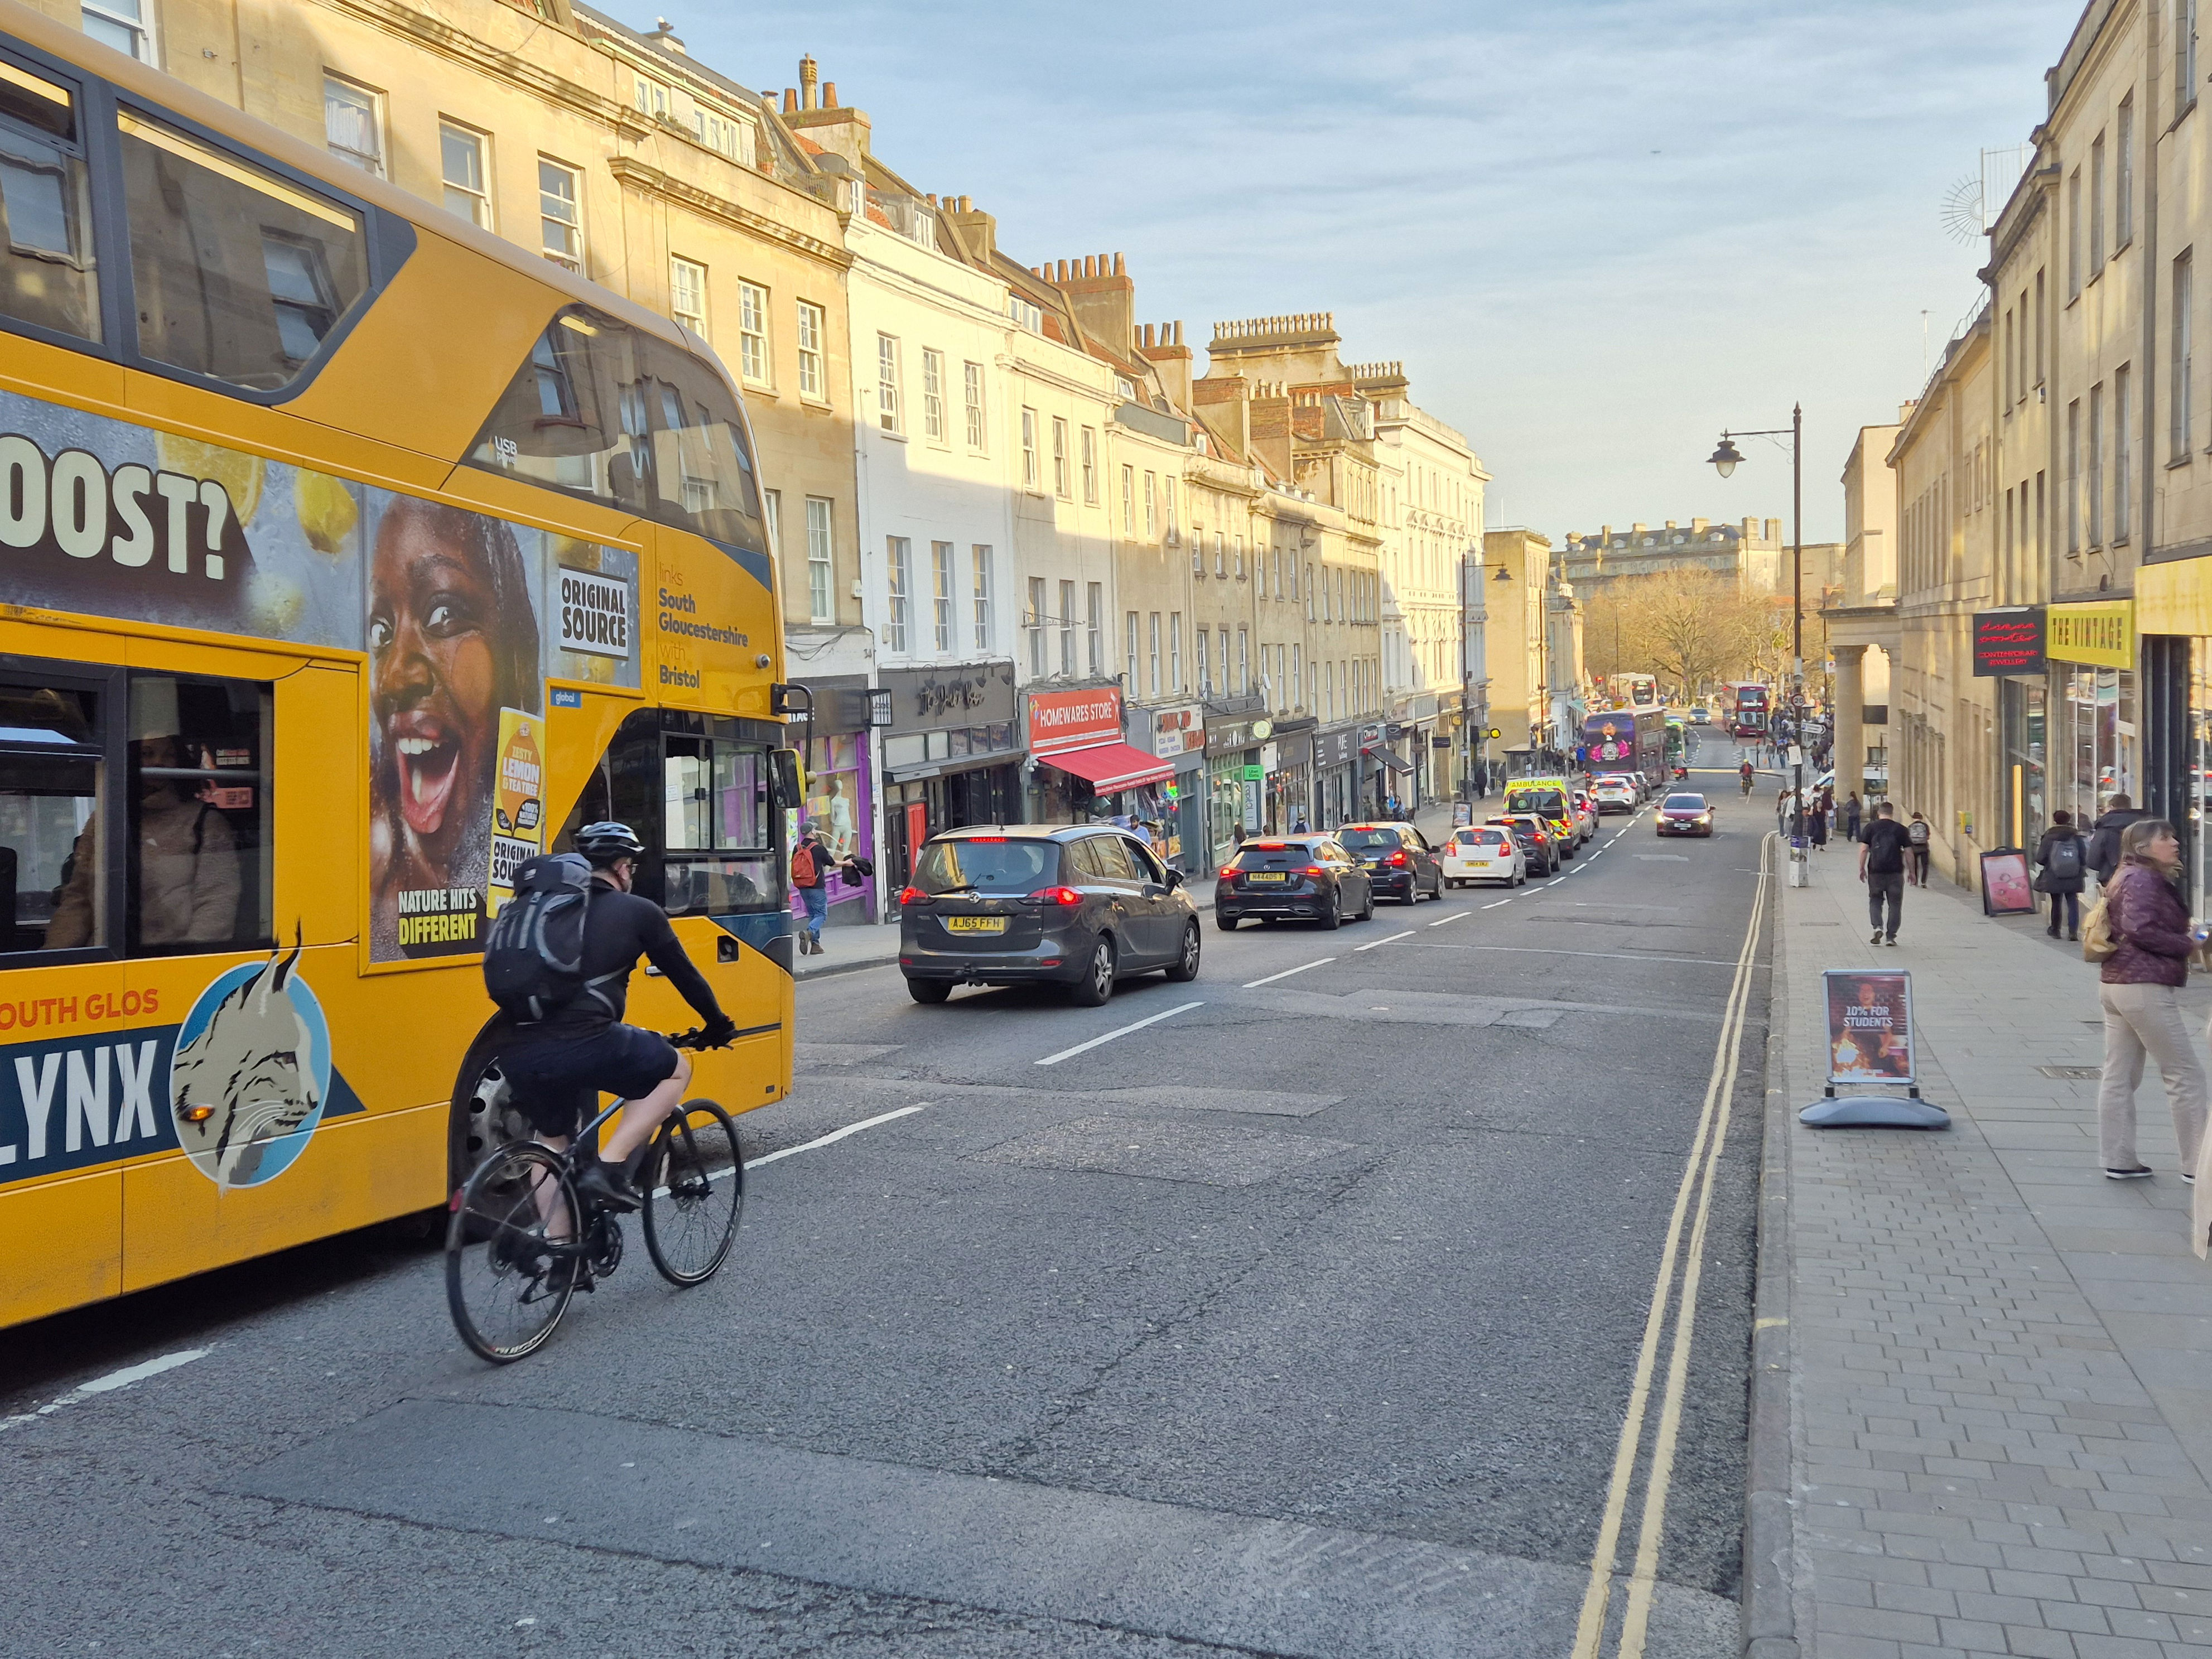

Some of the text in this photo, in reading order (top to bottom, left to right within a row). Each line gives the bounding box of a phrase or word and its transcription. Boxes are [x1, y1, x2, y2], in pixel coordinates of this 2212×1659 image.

[495, 435, 518, 456] USB
[659, 562, 683, 586] links
[562, 577, 625, 615] ORIGINAL
[659, 588, 696, 614] South
[562, 606, 626, 648] SOURCE
[659, 612, 749, 648] Gloucestershire
[2053, 616, 2122, 650] THE VINTAGE
[660, 643, 686, 661] with
[659, 664, 700, 688] Bristol
[556, 692, 575, 705] global
[1040, 702, 1112, 727] HOMEWARES STORE
[513, 745, 532, 758] ZESTY
[503, 757, 540, 784] LEMON
[398, 889, 447, 913] NATURE
[450, 888, 477, 910] HITS
[398, 913, 477, 946] DIFFERENT
[953, 918, 1000, 928] AJ65 FFH
[85, 988, 159, 1019] GLOS
[1846, 1006, 1890, 1016] 10% FOR
[1843, 1017, 1893, 1027] STUDENTS
[0, 1039, 158, 1165] YNX
